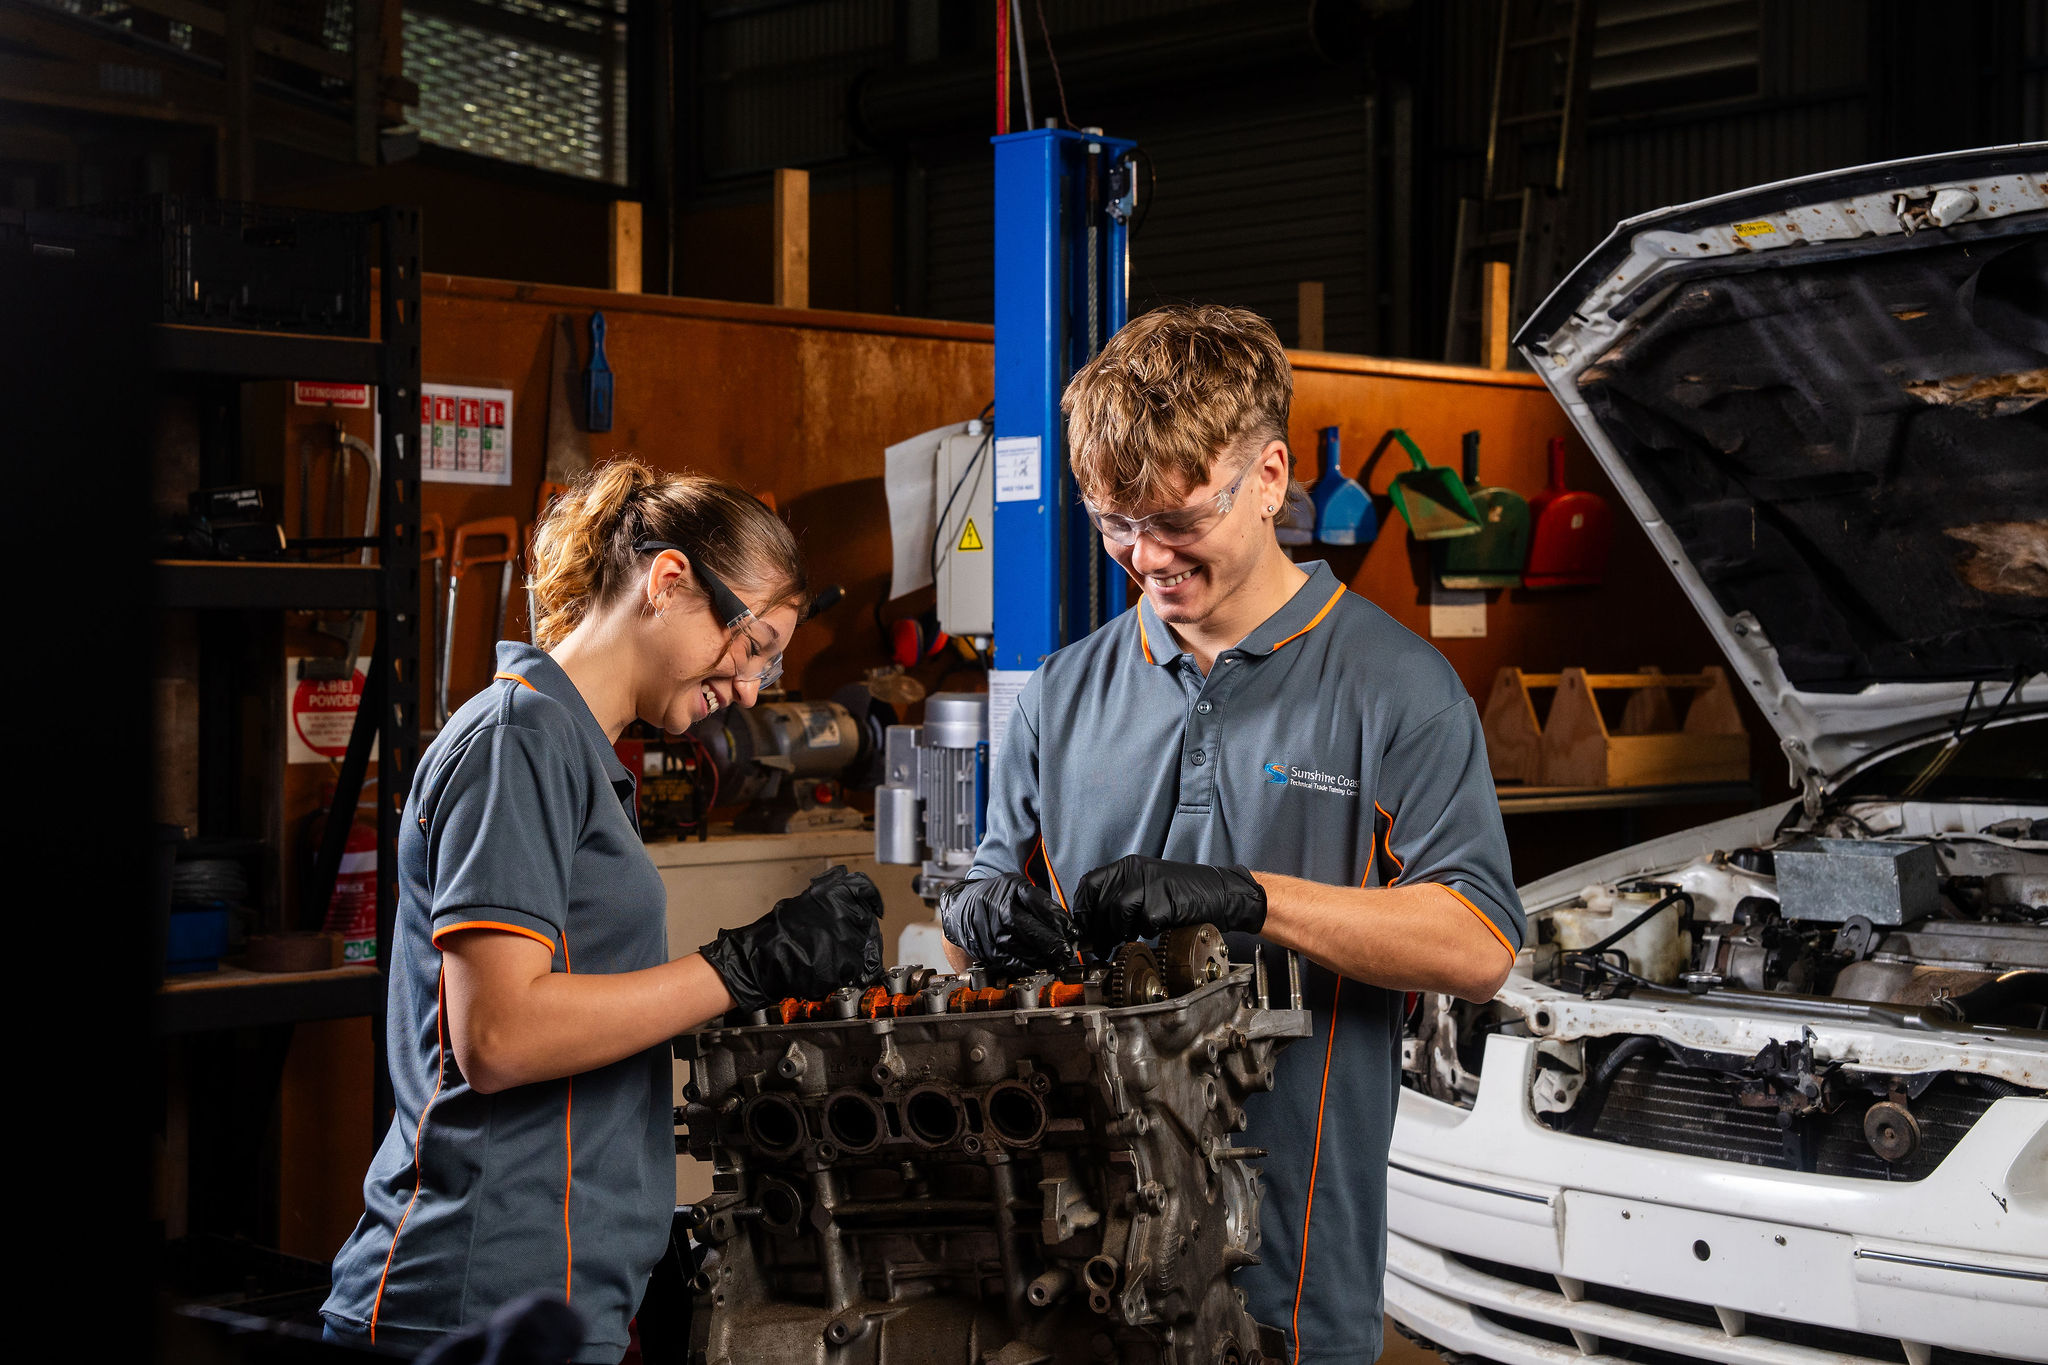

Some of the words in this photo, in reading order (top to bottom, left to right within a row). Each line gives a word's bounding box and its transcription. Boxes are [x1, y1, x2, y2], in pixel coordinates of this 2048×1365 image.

[308, 694, 361, 707] POWDER
[1291, 766, 1336, 784] Sunshine
[1290, 779, 1312, 789] Technical
[1313, 783, 1328, 792] Trade
[1328, 786, 1346, 796] Training
